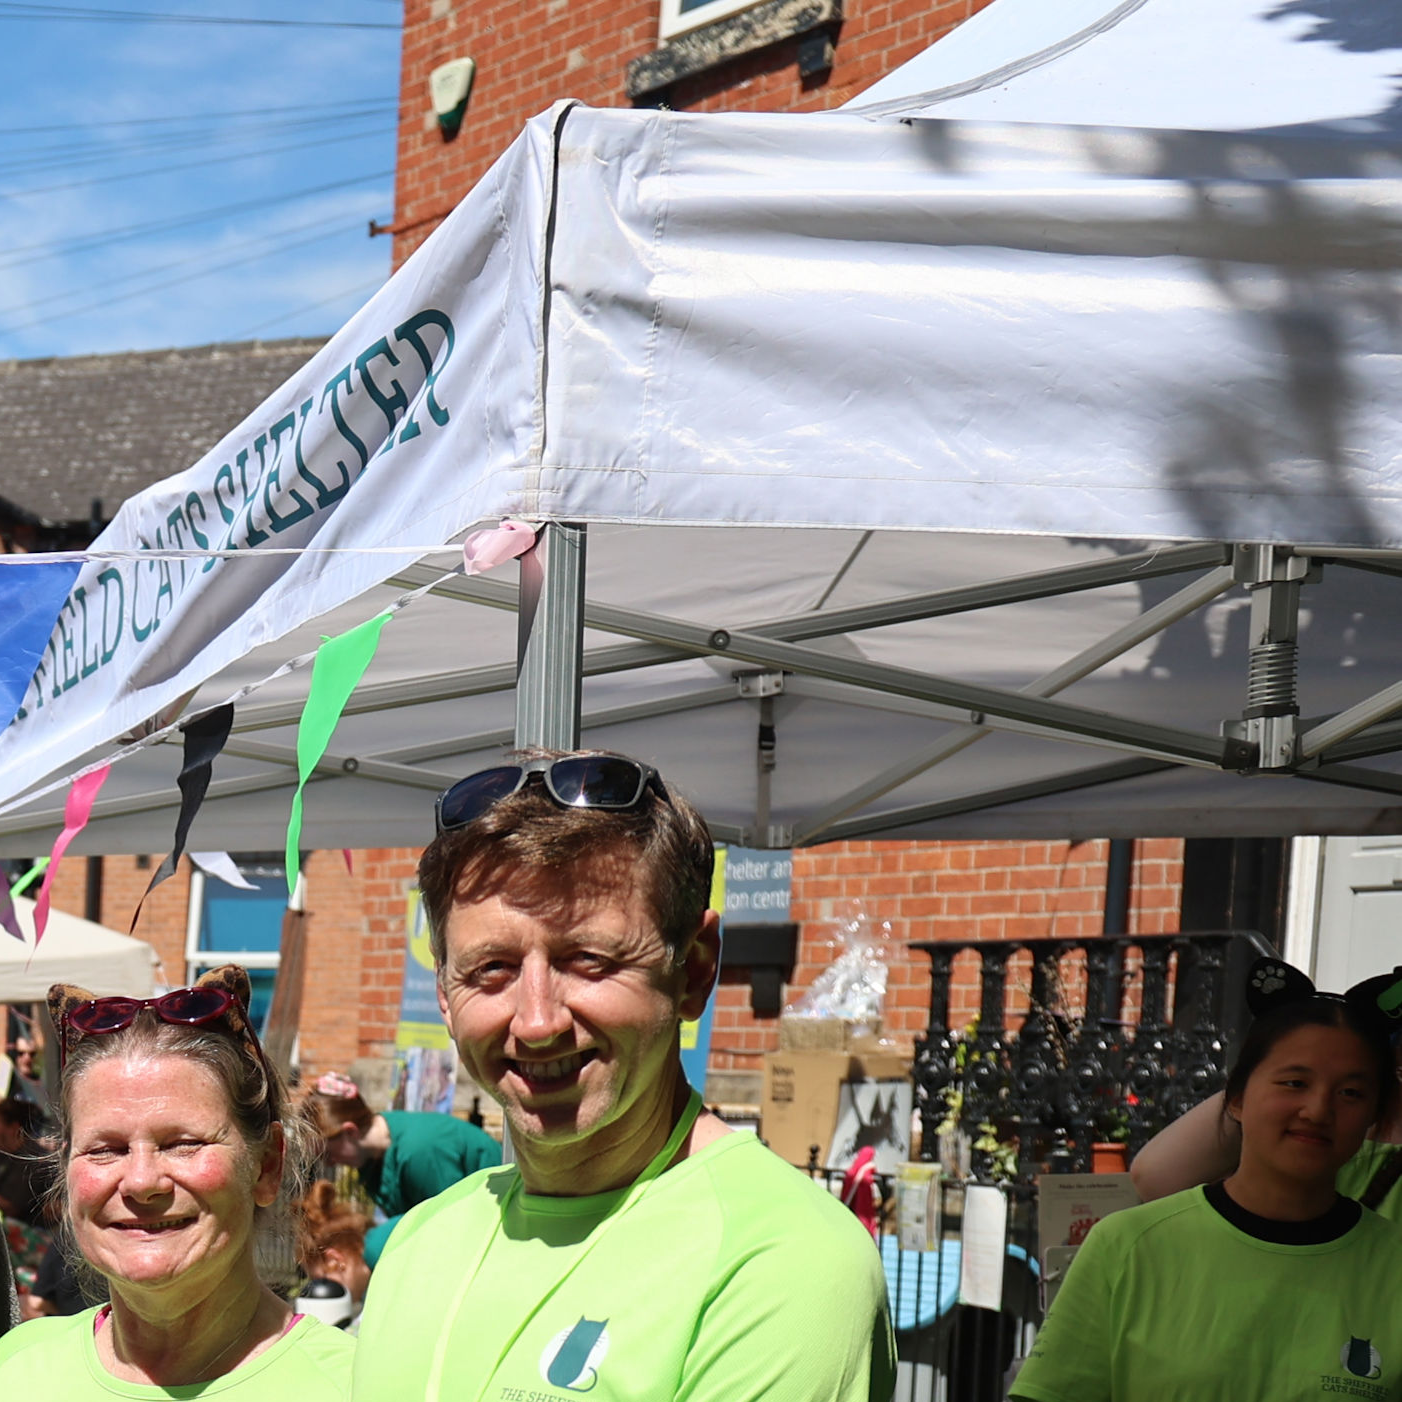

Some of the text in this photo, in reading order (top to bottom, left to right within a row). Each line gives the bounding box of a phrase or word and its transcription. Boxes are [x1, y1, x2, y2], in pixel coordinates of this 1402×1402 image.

[131, 490, 216, 643] CATS
[214, 308, 456, 561] SHELTER
[500, 1387, 526, 1402] THE
